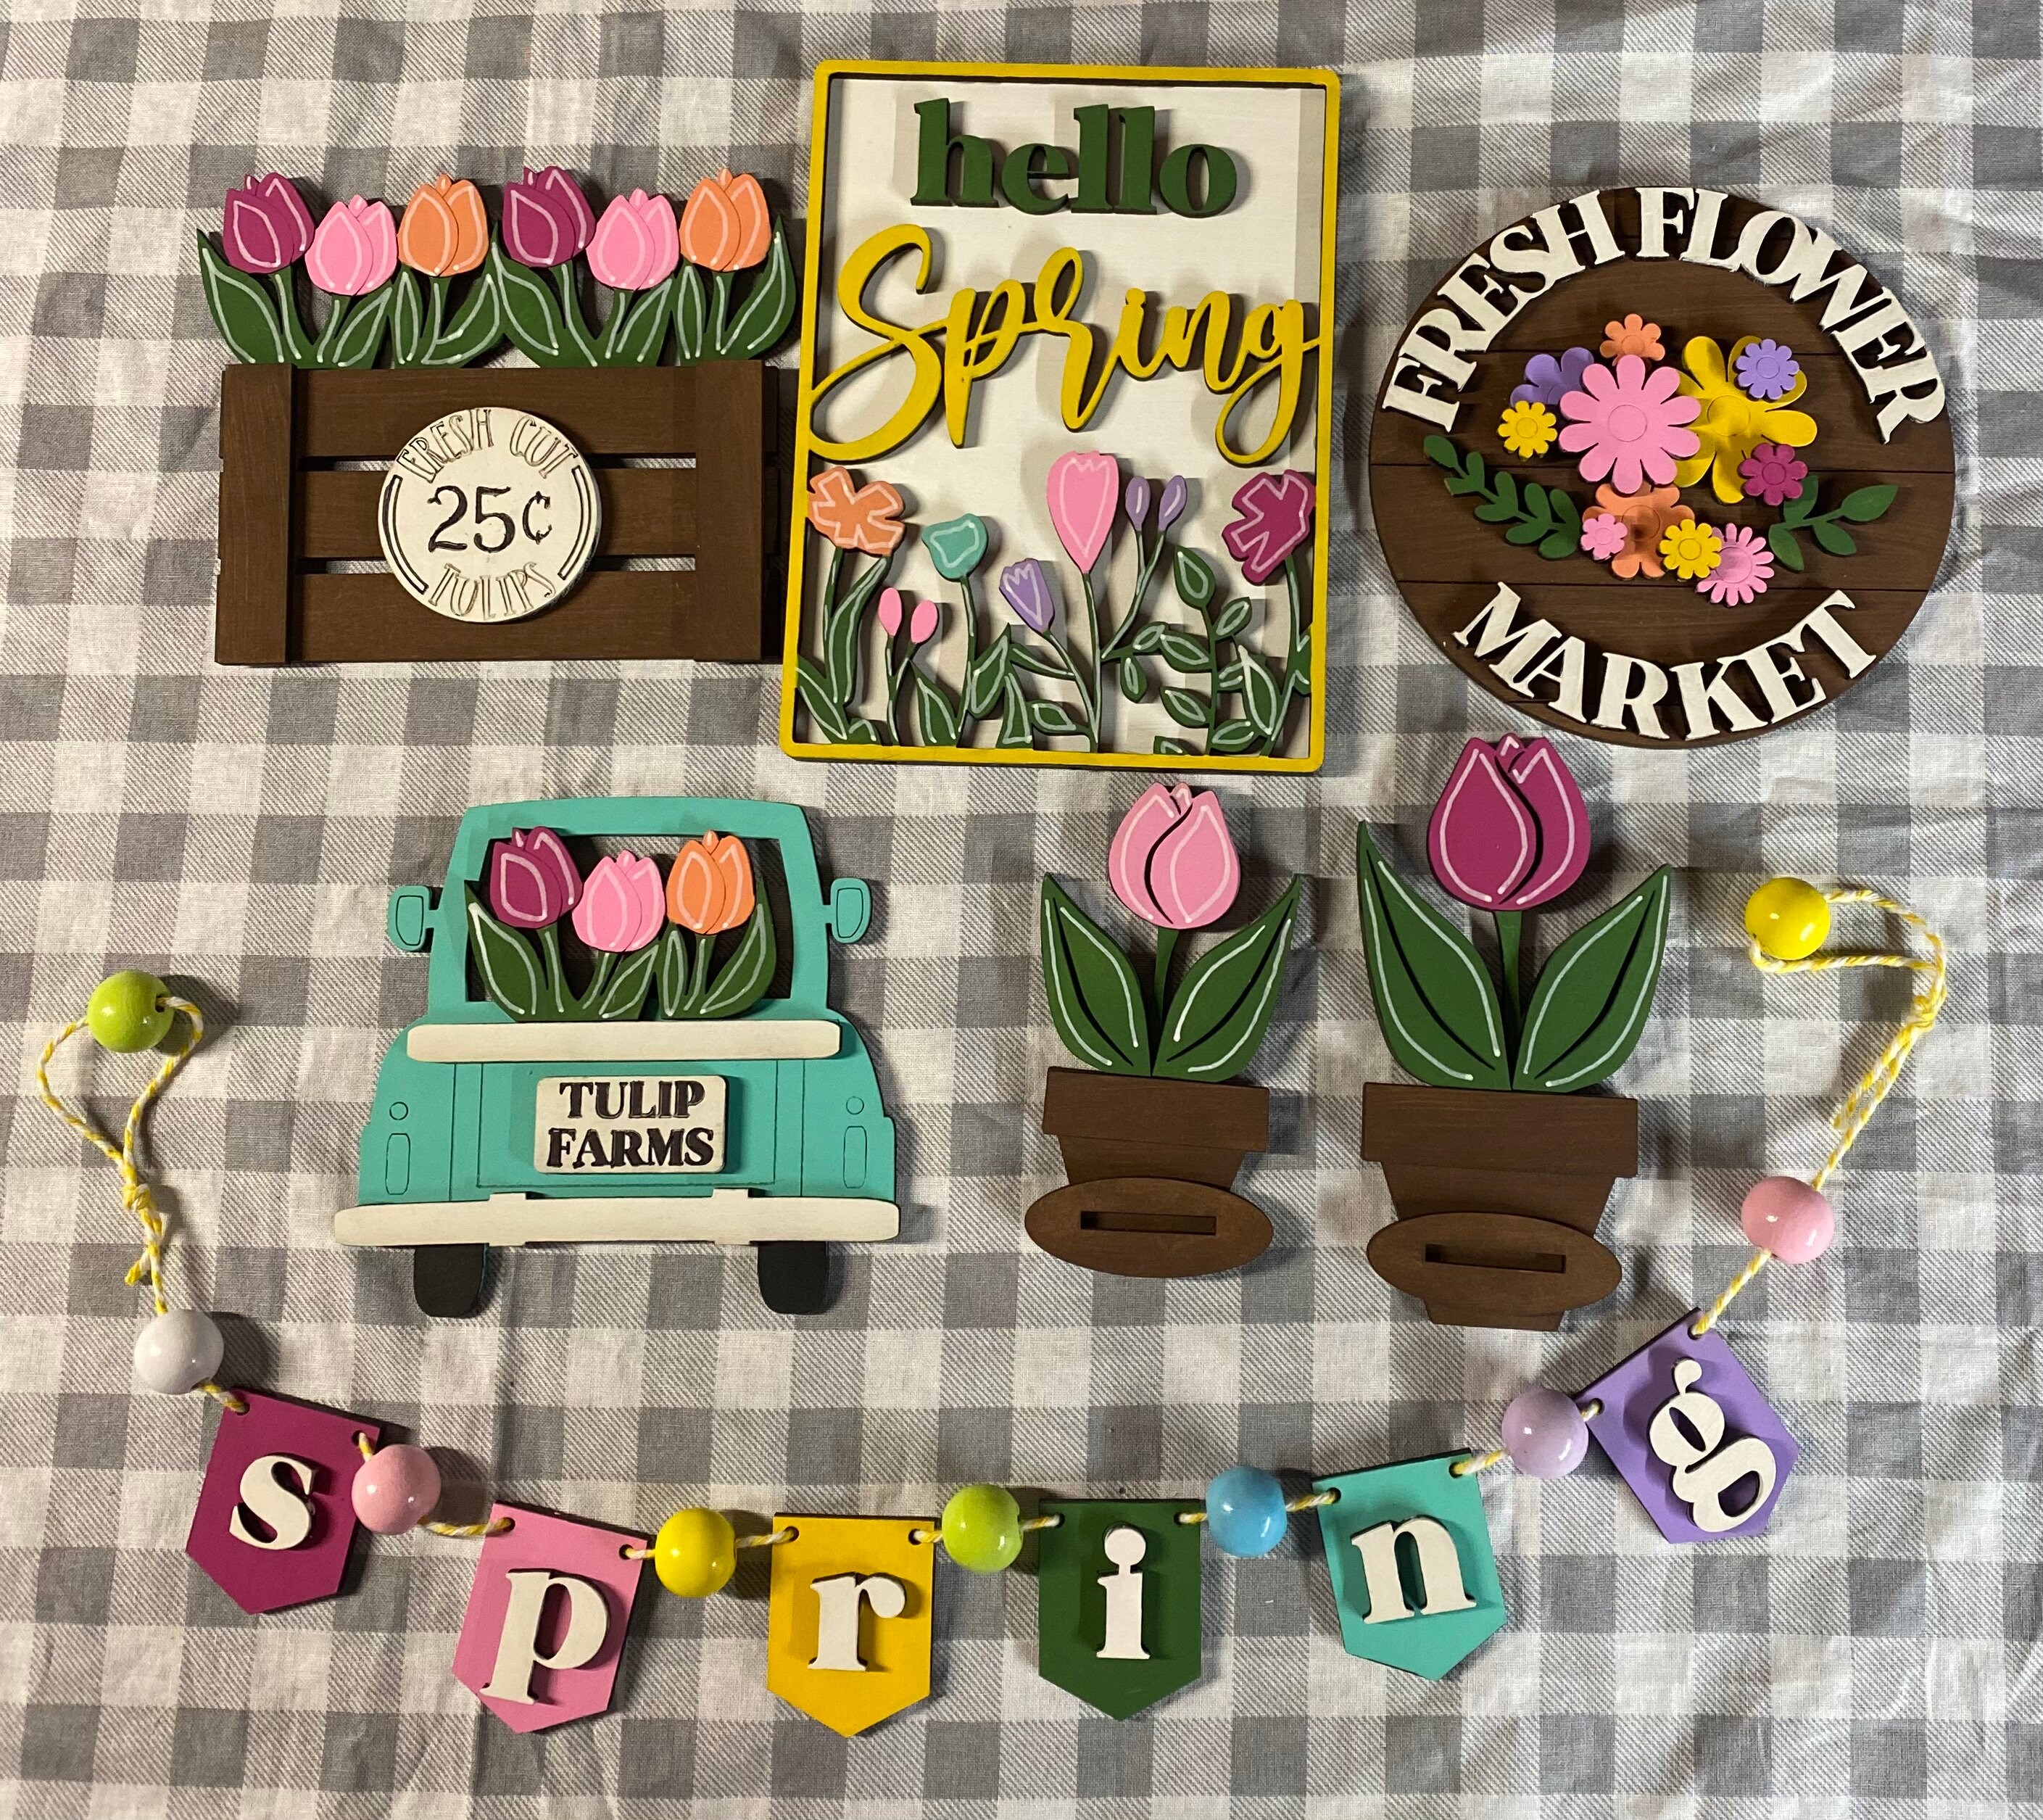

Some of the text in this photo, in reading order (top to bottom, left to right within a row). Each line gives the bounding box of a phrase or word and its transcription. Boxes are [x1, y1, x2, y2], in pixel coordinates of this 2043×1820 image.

[911, 97, 1238, 218] hello
[810, 224, 1320, 468] Spring
[1381, 186, 1946, 444] FRESH FLOWER
[396, 408, 579, 484] FRESH CUT
[426, 484, 552, 553] 25¢
[428, 561, 556, 621] TULIPS
[1452, 582, 1877, 742] MARKET
[558, 1080, 705, 1120] TULIP
[546, 1127, 715, 1170] FARMS
